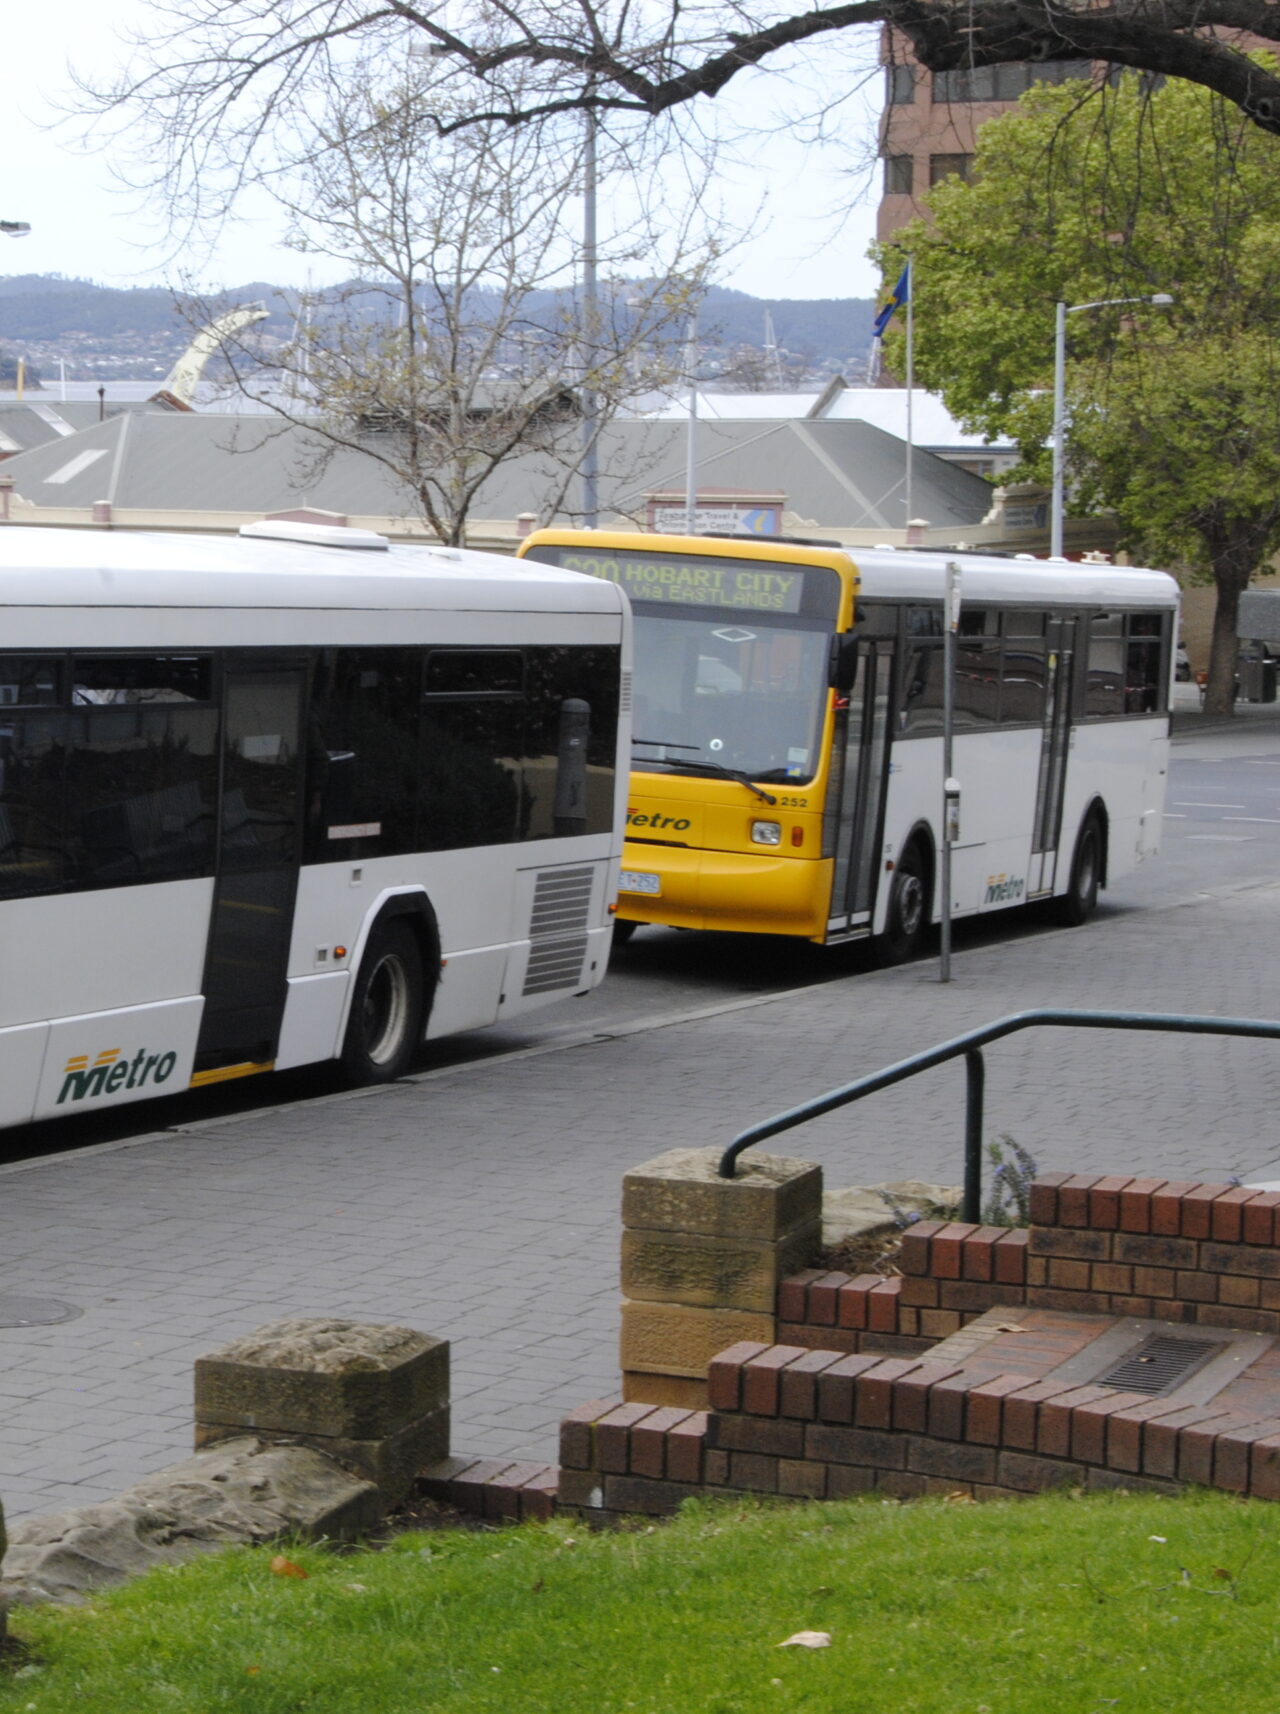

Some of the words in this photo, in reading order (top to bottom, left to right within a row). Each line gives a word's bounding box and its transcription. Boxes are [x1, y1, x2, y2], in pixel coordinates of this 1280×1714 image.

[625, 563, 726, 589] HOBART
[736, 571, 796, 594] CITY
[670, 585, 784, 609] EASTLANDS
[781, 797, 808, 808] 252
[984, 873, 1024, 904] Metro
[56, 1048, 177, 1105] Metro
